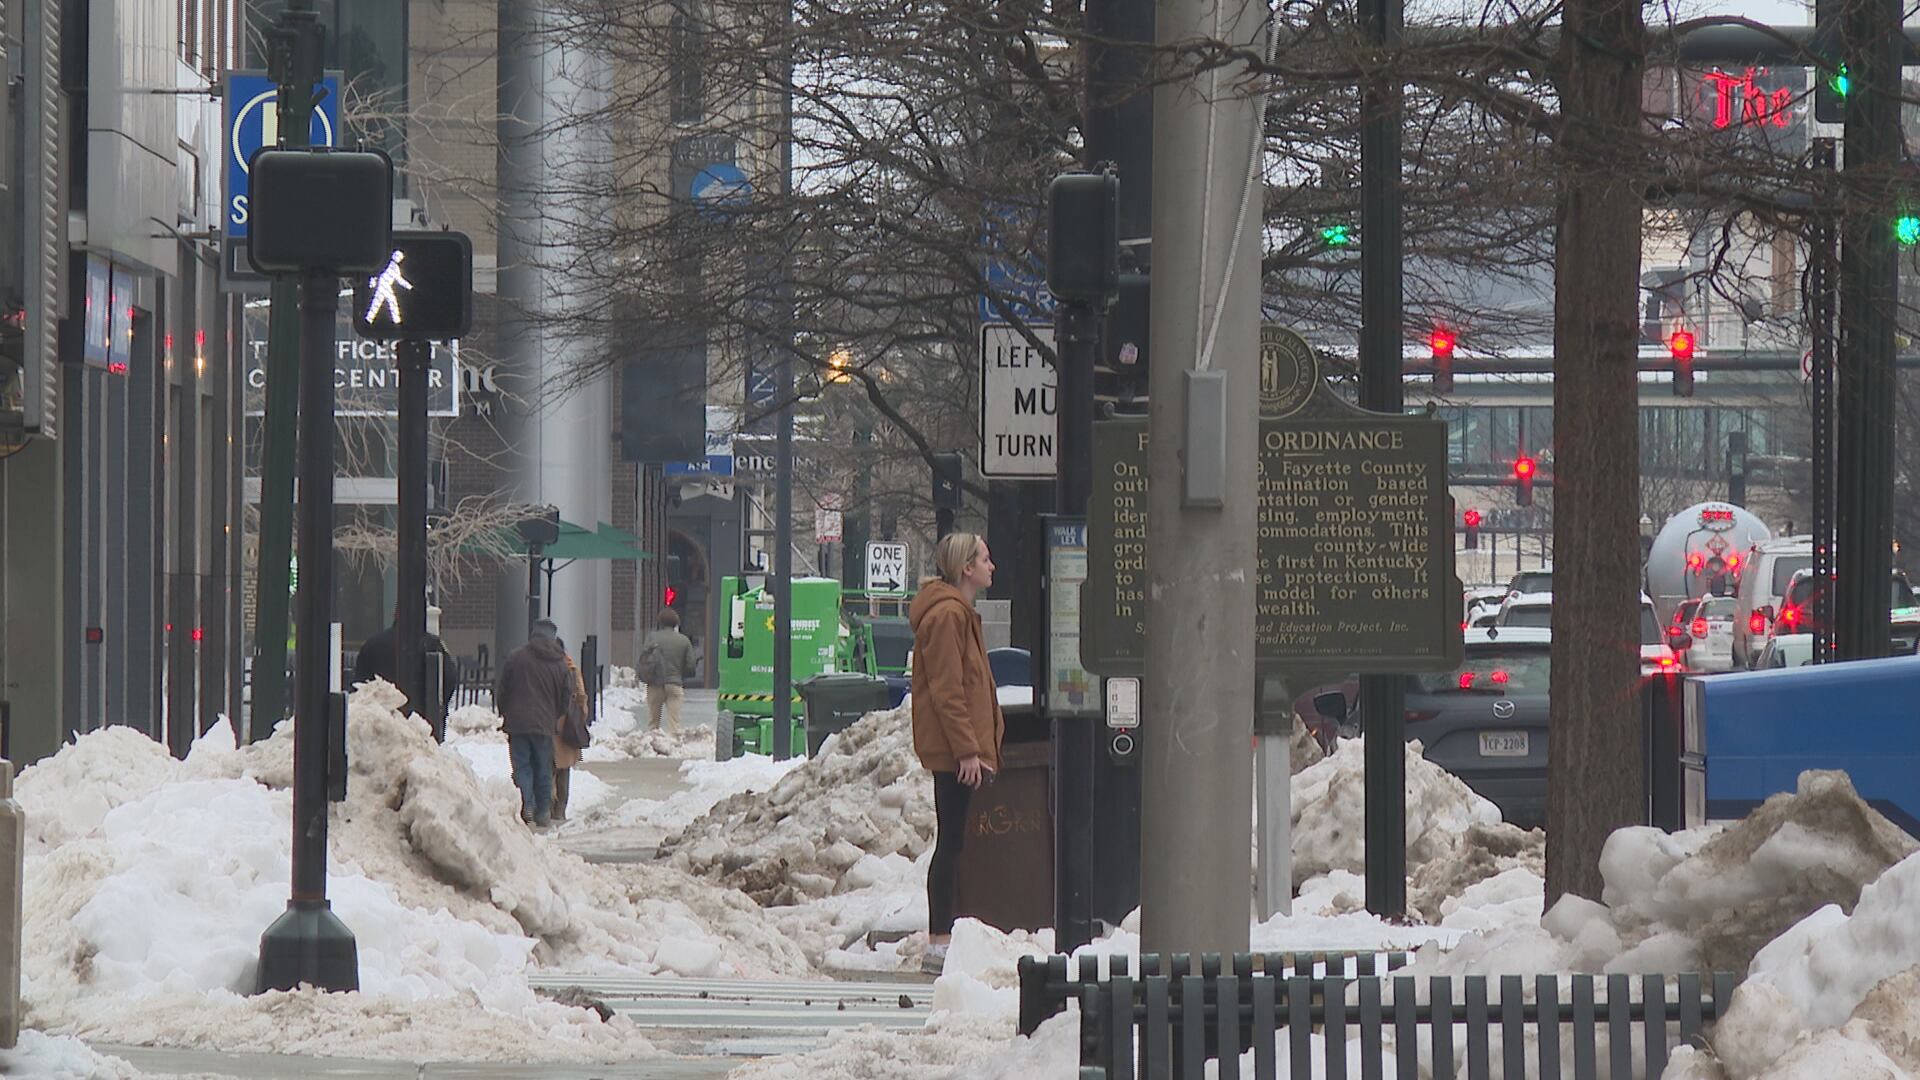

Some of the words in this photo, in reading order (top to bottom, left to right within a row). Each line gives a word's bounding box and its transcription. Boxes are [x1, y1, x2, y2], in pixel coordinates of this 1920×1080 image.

[1703, 66, 1792, 129] The
[249, 341, 267, 360] T
[335, 340, 398, 360] FICES
[334, 369, 442, 388] CENTR
[995, 434, 1052, 457] TURN
[1265, 431, 1404, 450] ORDINANCE
[1114, 461, 1139, 476] On
[1282, 461, 1351, 478] Fayette
[1361, 460, 1427, 477] County
[1377, 476, 1428, 491] based
[1114, 496, 1135, 507] on
[1334, 495, 1354, 507] or
[1369, 491, 1428, 508] gender
[1054, 526, 1076, 537] WALK
[1114, 525, 1146, 538] and
[1257, 524, 1375, 538] ommodations.
[1389, 522, 1429, 537] This
[1061, 535, 1076, 545] LEX
[1314, 538, 1429, 555] county-wide
[873, 546, 902, 561] ONE
[871, 563, 902, 577] WAY
[1277, 555, 1316, 569] first
[1323, 555, 1338, 569] in
[1345, 554, 1428, 570] Kentucky
[1115, 572, 1133, 585] to
[1284, 570, 1392, 587] protections.
[1413, 570, 1428, 584] It
[1115, 587, 1144, 601] has
[1264, 586, 1316, 600] model
[1331, 586, 1357, 600] for
[1371, 586, 1429, 600] others
[1115, 603, 1132, 617] in
[1256, 601, 1321, 616] wealth.
[1279, 621, 1333, 633] Education
[1390, 621, 1410, 633] Inc.
